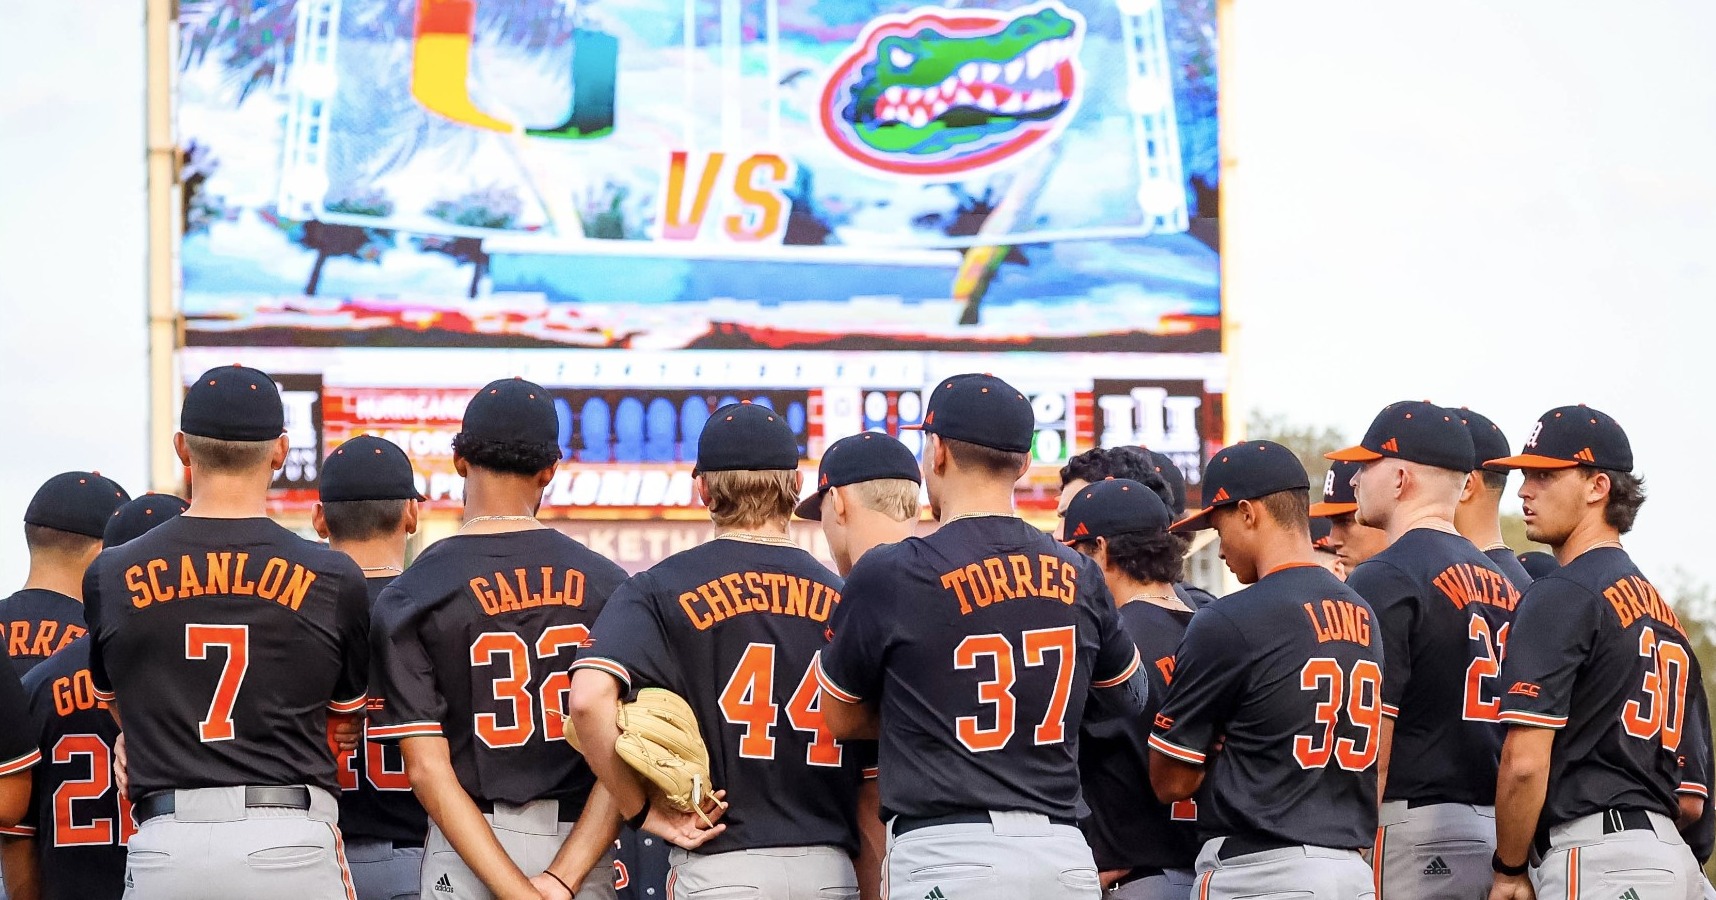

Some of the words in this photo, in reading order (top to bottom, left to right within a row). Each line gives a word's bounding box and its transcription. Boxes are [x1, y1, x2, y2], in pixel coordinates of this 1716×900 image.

[543, 469, 693, 506] LORIDA
[124, 552, 318, 612] SCANLON
[469, 566, 586, 616] GALLO
[678, 571, 842, 632] CHESTNU
[939, 553, 1078, 616] TORRES
[1303, 599, 1371, 648] LONG
[52, 668, 110, 718] GO
[185, 623, 249, 743] 7
[469, 623, 591, 749] 32
[717, 642, 844, 768] 44
[953, 624, 1077, 753] 37
[1507, 680, 1542, 699] ACC
[1621, 625, 1690, 753] 30
[1292, 657, 1383, 772] 39
[434, 884, 454, 894] adidas
